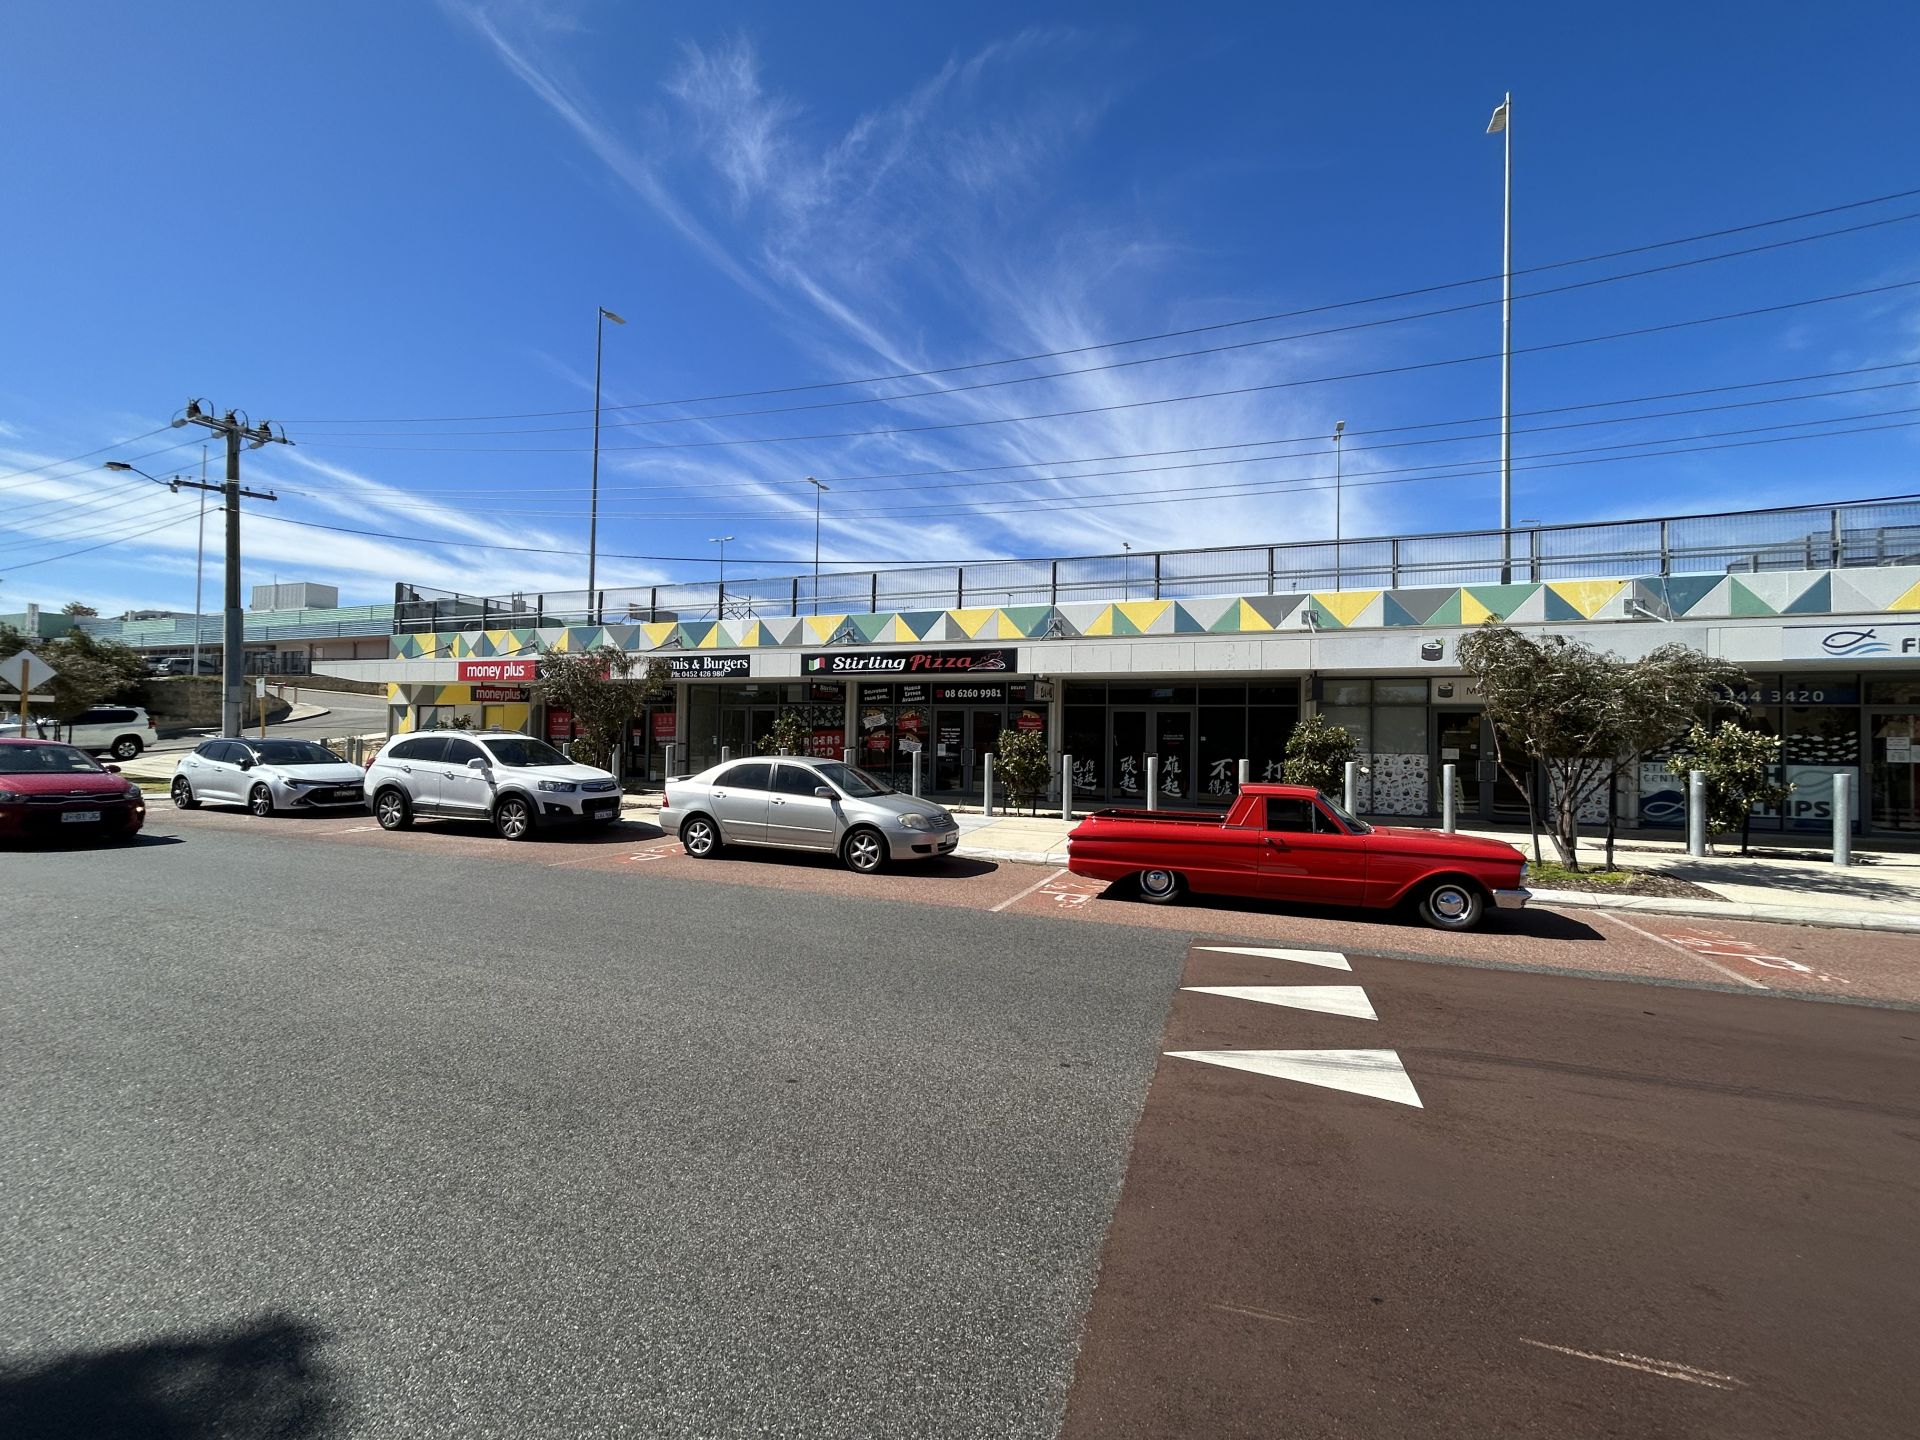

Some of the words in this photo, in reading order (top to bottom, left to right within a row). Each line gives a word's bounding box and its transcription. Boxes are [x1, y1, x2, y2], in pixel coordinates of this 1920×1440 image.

[692, 659, 700, 669] &
[703, 656, 748, 672] Burgers
[832, 656, 906, 672] Stirling
[909, 654, 972, 671] Pizza
[467, 665, 501, 680] money
[503, 662, 525, 680] plus
[681, 670, 698, 678] 0452
[699, 670, 711, 678] 426
[712, 670, 725, 678] 980
[944, 688, 956, 698] 08
[957, 688, 978, 698] 6260
[980, 688, 1002, 698] 9981
[1770, 690, 1825, 702] 3420
